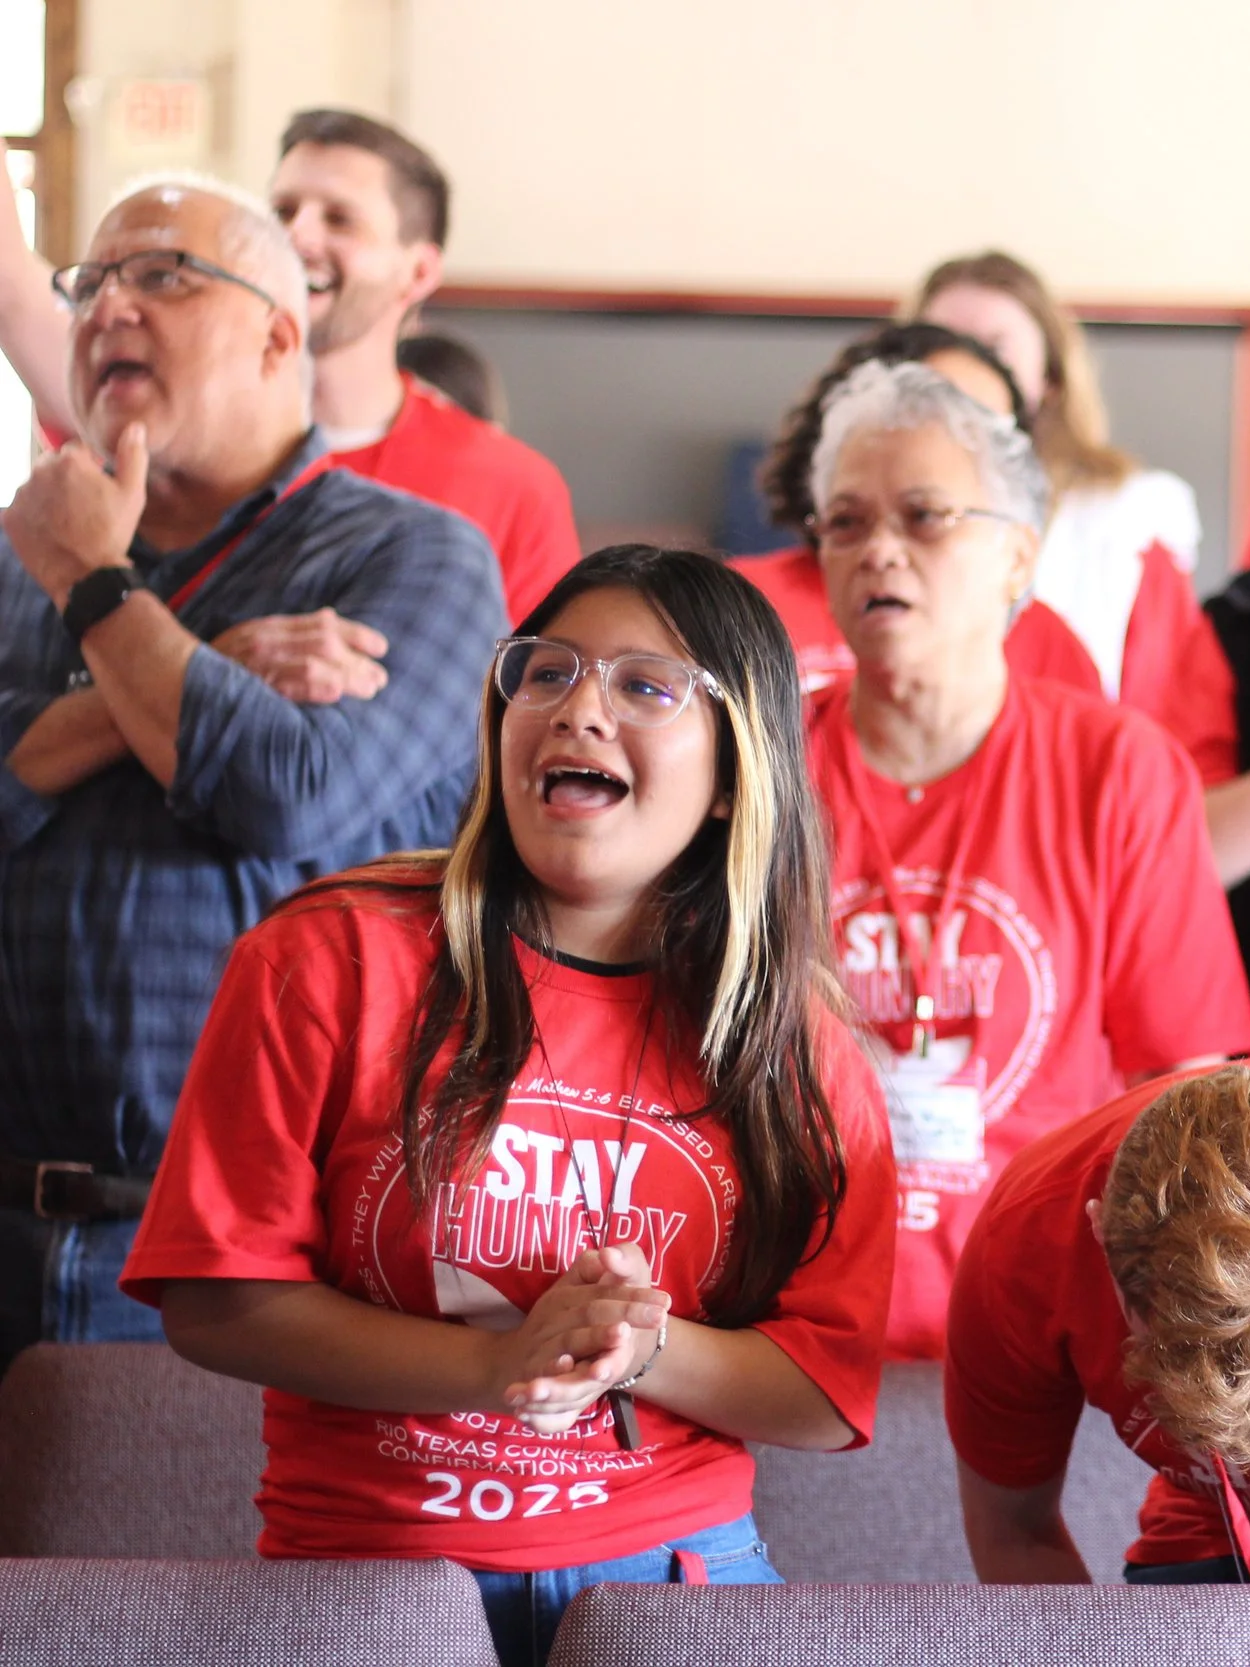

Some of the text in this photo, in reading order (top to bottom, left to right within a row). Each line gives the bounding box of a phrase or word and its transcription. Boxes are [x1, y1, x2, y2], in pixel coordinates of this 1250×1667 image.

[582, 1087, 612, 1105] 5:6
[485, 1123, 648, 1214] STAY
[711, 1164, 736, 1209] ARE
[352, 1185, 372, 1246] THEY
[375, 1419, 408, 1442] RIO
[413, 1429, 497, 1458] TEXAS
[377, 1440, 655, 1477] CONFIRMATION RALLY
[420, 1471, 610, 1522] 2025
